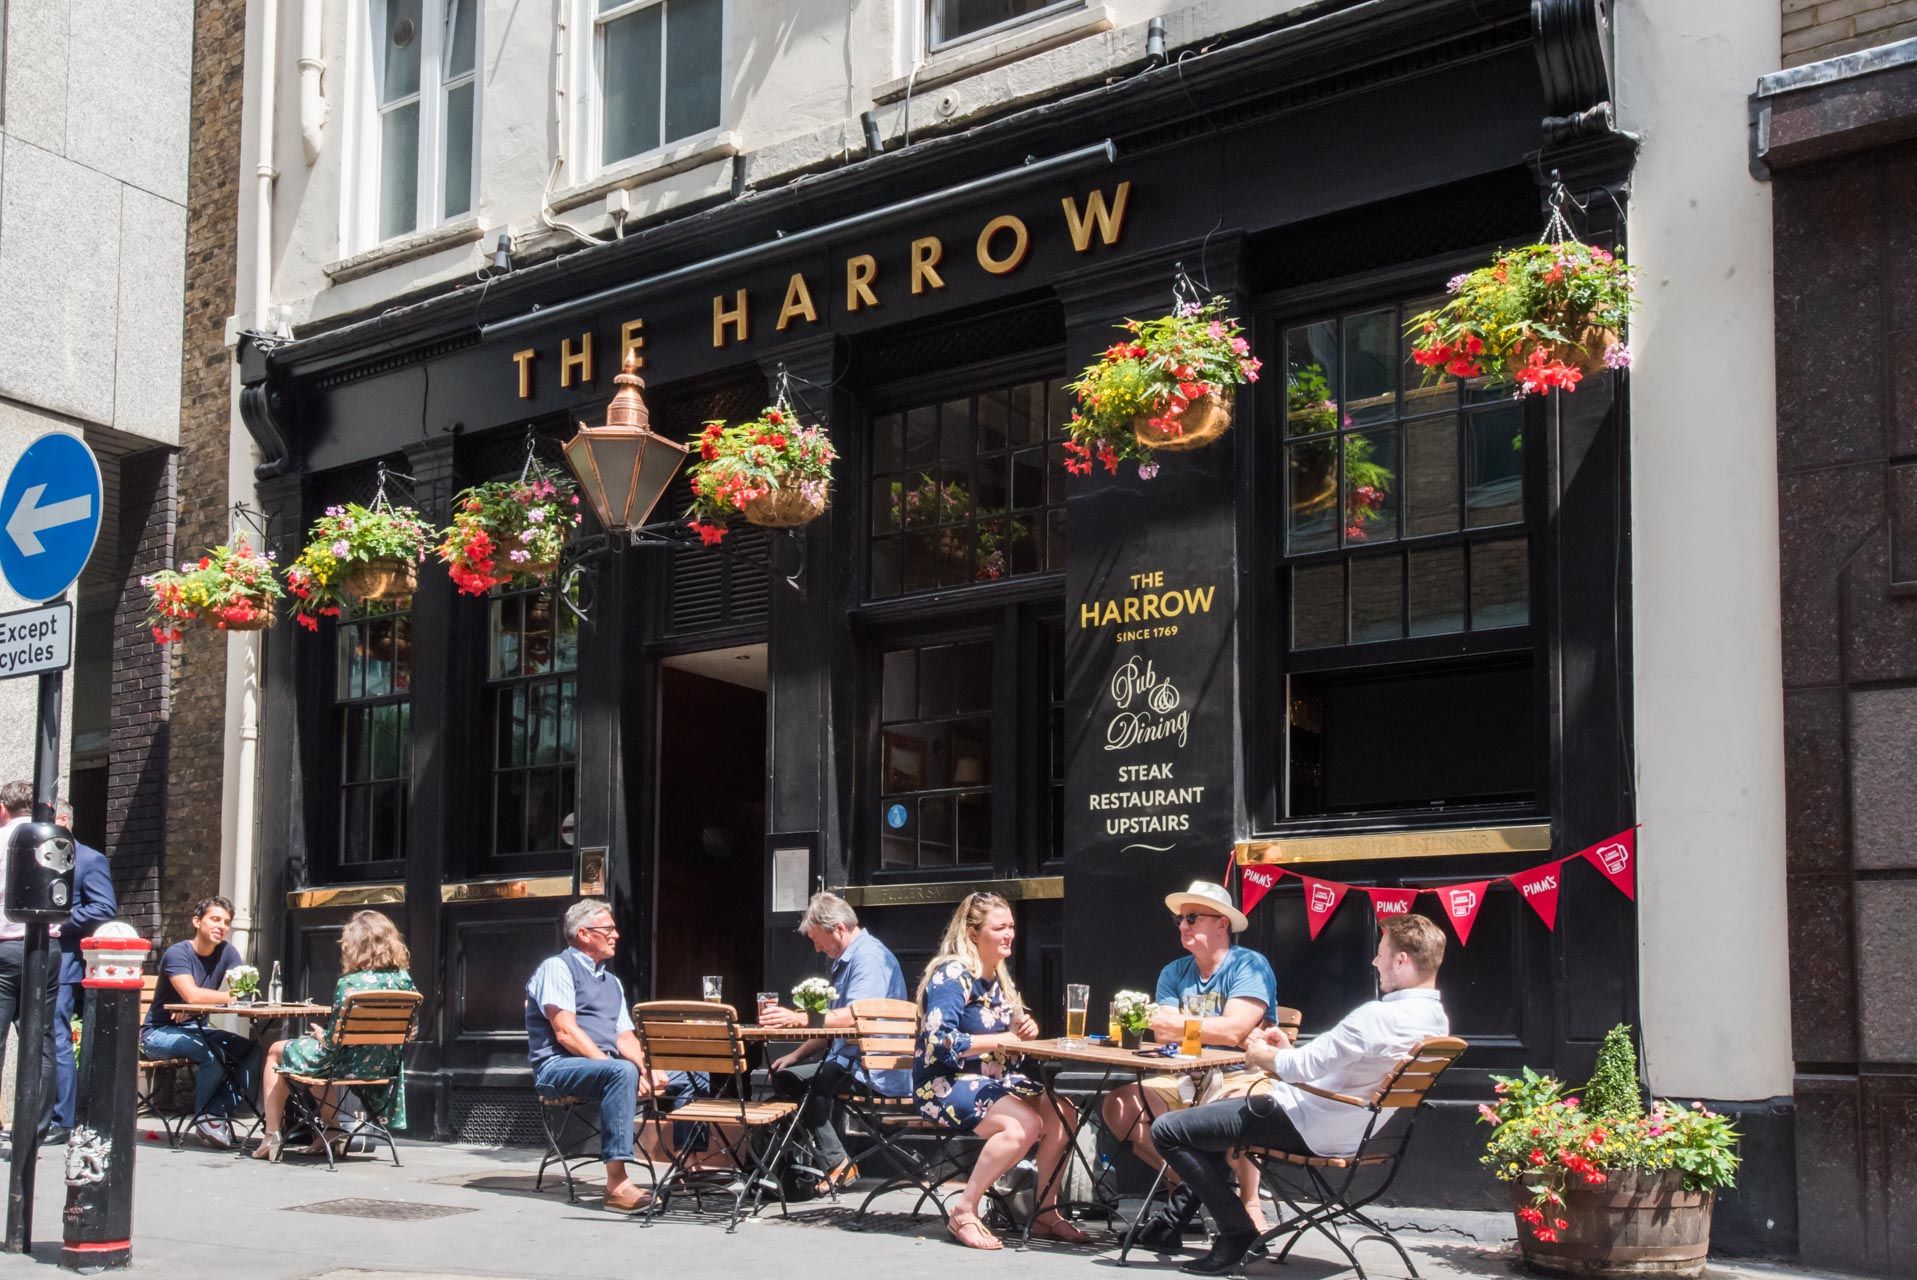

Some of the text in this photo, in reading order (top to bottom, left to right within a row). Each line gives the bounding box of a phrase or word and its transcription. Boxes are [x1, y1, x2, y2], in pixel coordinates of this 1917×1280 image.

[512, 180, 1131, 398] THE HARROW
[1130, 571, 1164, 590] THE
[1080, 586, 1216, 628] HARROW
[1116, 626, 1179, 643] SINCE 1769
[0, 642, 54, 671] cycles
[1111, 655, 1180, 714] Pub &
[1104, 710, 1191, 750] Dining
[1118, 762, 1174, 783] STEAK
[1089, 786, 1205, 811] RESTAURANT
[1106, 814, 1190, 835] UPSTAIRS
[1243, 868, 1273, 888] PIMM'S
[1522, 875, 1557, 897] PIMM'S
[1376, 900, 1408, 914] PIMM'S
